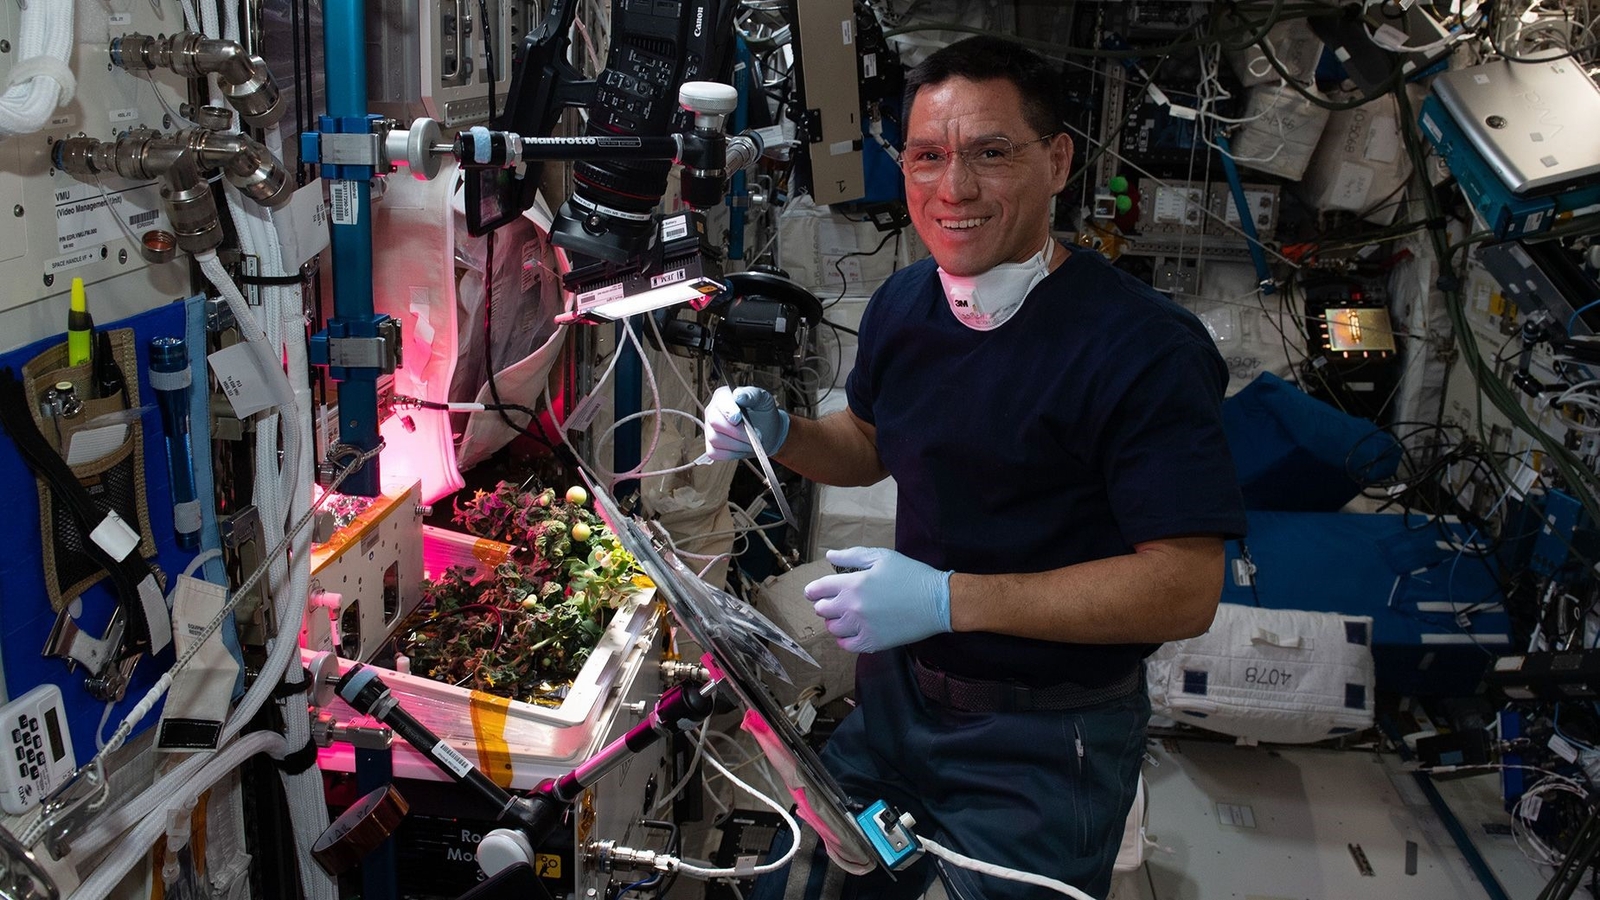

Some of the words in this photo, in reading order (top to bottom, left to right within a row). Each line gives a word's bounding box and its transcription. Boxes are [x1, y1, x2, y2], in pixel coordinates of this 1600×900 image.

[693, 6, 704, 37] Canon
[525, 137, 596, 145] Manfrotto
[55, 191, 70, 201] VMU
[56, 204, 75, 219] (Video
[75, 199, 107, 212] Managemen
[51, 259, 65, 269] SPACE
[65, 255, 82, 266] HANDLE
[661, 273, 675, 284] JEM
[1244, 667, 1292, 685] 4078
[476, 869, 485, 881] 3
